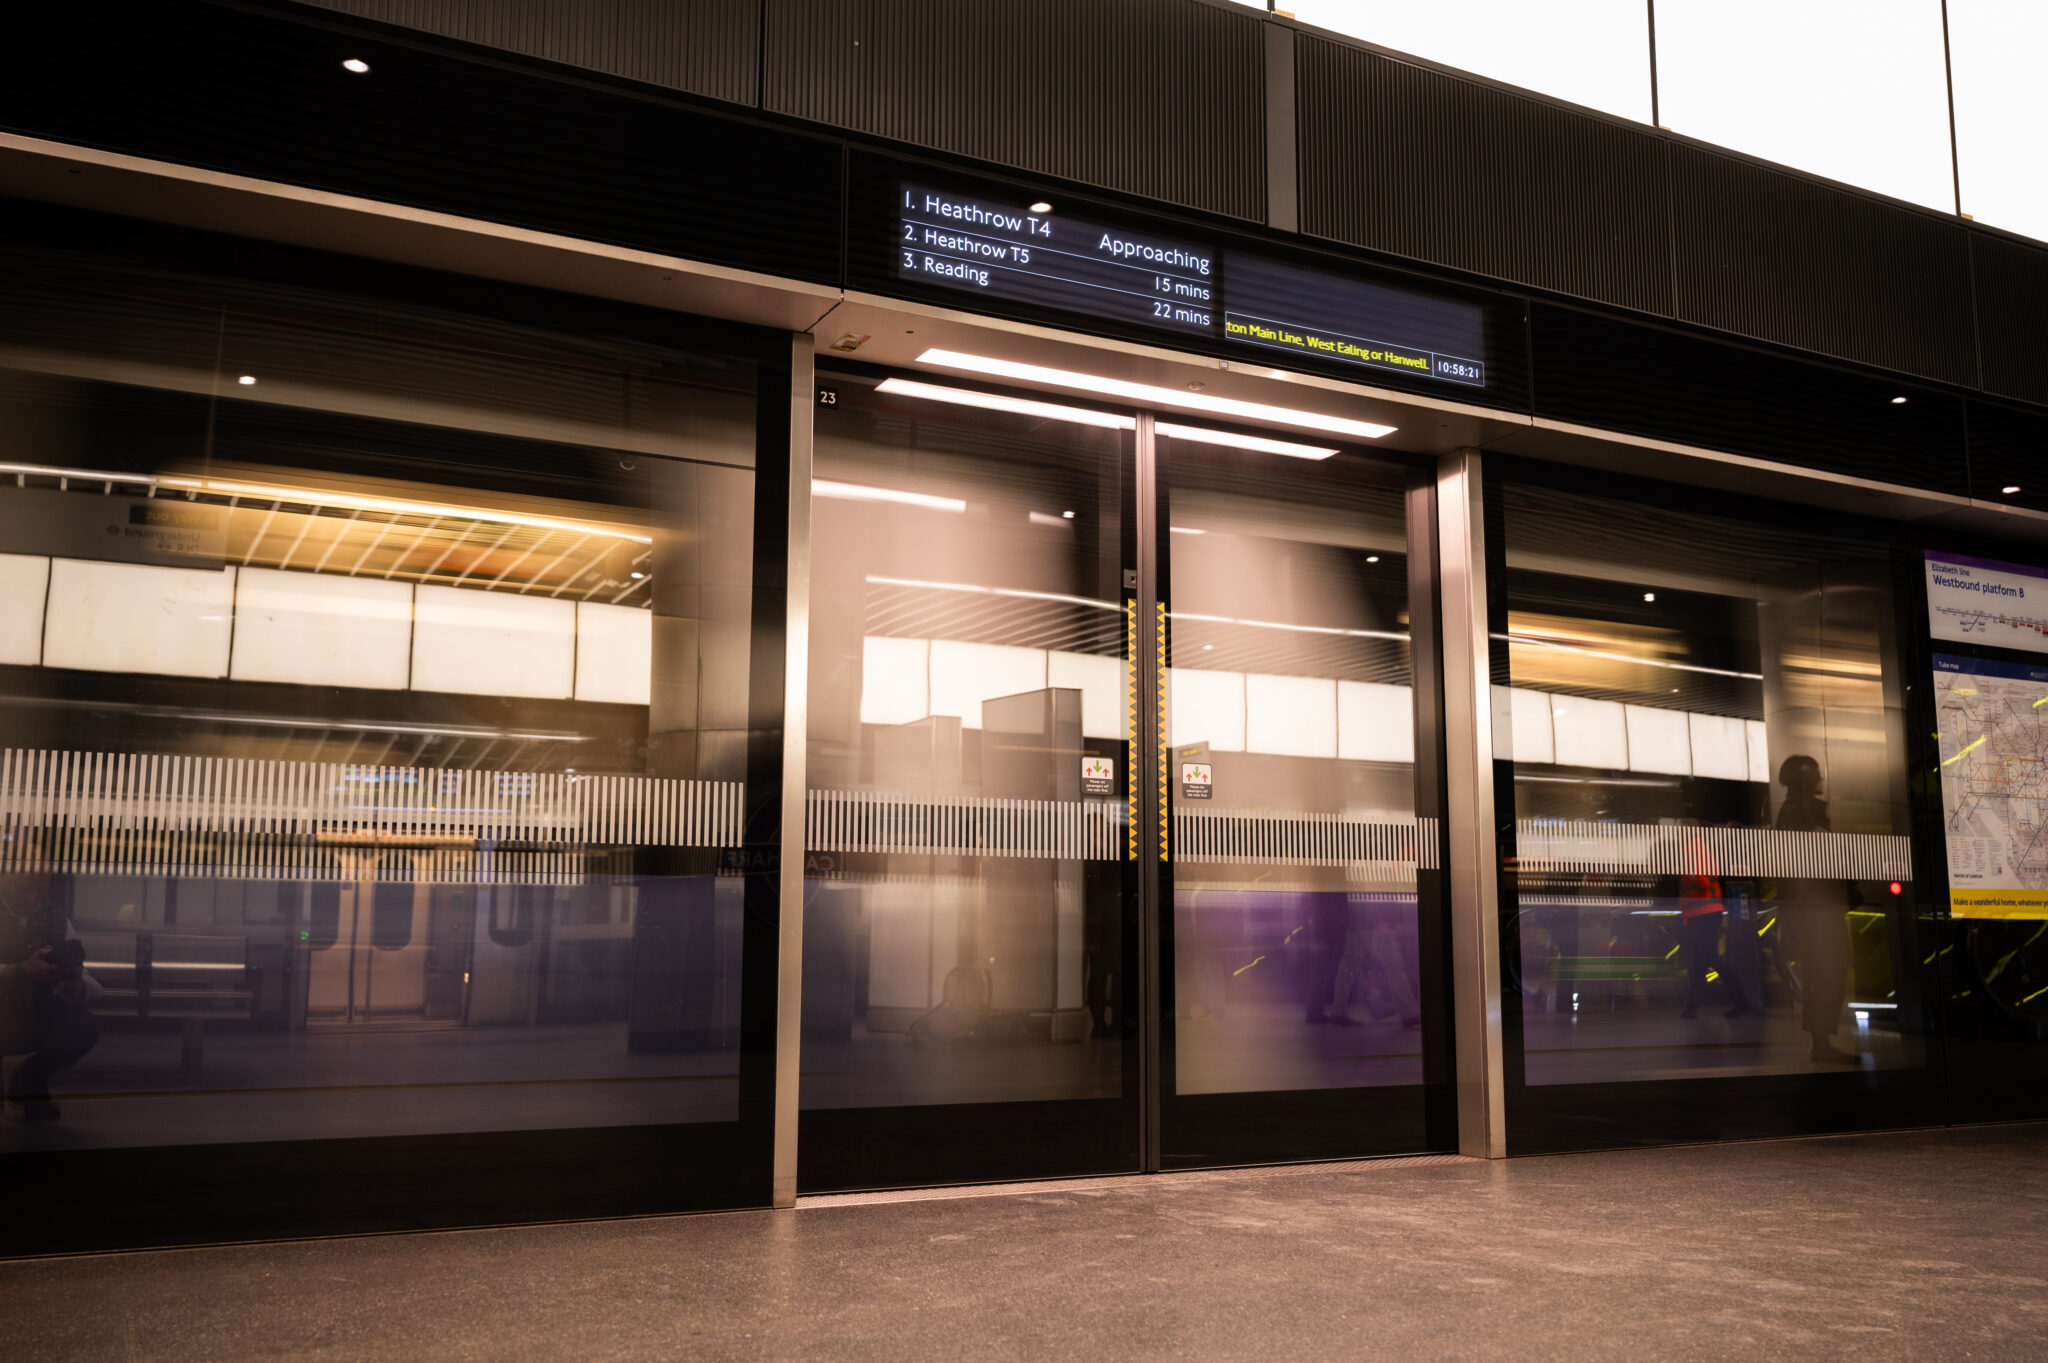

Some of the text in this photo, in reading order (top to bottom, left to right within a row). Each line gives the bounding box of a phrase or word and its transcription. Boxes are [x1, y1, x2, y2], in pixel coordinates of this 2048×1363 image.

[905, 190, 1051, 238] 1. Heathrow T4
[904, 225, 1030, 264] 2. Heathrow T5
[1100, 234, 1210, 275] Approaching
[904, 252, 990, 287] 3. Reading
[1155, 276, 1210, 300] 15 mins
[1154, 302, 1210, 326] 22 mins
[1249, 325, 1277, 341] Main
[1306, 336, 1336, 352] West
[1338, 342, 1370, 361] Ealing
[1371, 350, 1383, 362] or
[1438, 361, 1479, 379] 10:58:21
[820, 391, 836, 404] 23
[1932, 563, 1970, 576] Elizabeth line
[1933, 574, 2024, 598] Westbound platform B
[1938, 661, 1949, 669] Tube
